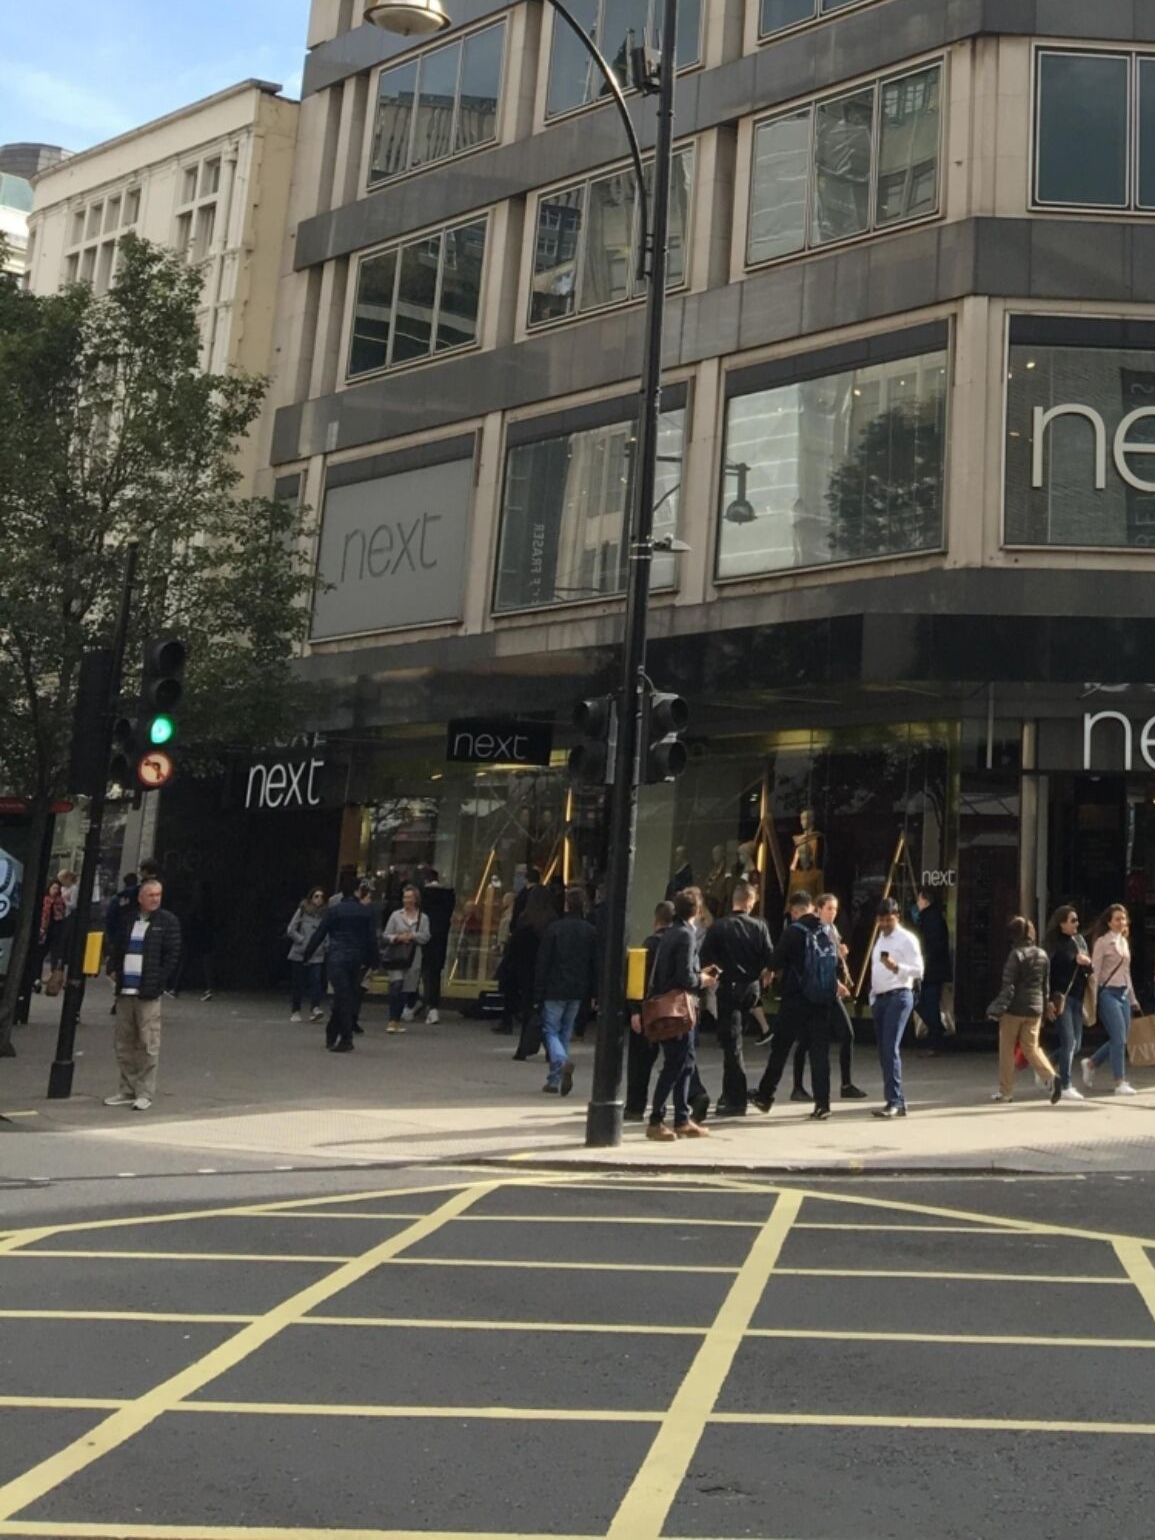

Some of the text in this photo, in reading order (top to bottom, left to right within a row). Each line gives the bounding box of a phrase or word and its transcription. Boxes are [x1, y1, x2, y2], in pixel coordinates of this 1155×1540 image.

[341, 512, 442, 582] next
[453, 732, 528, 760] next
[245, 758, 325, 809] next
[921, 868, 956, 887] next
